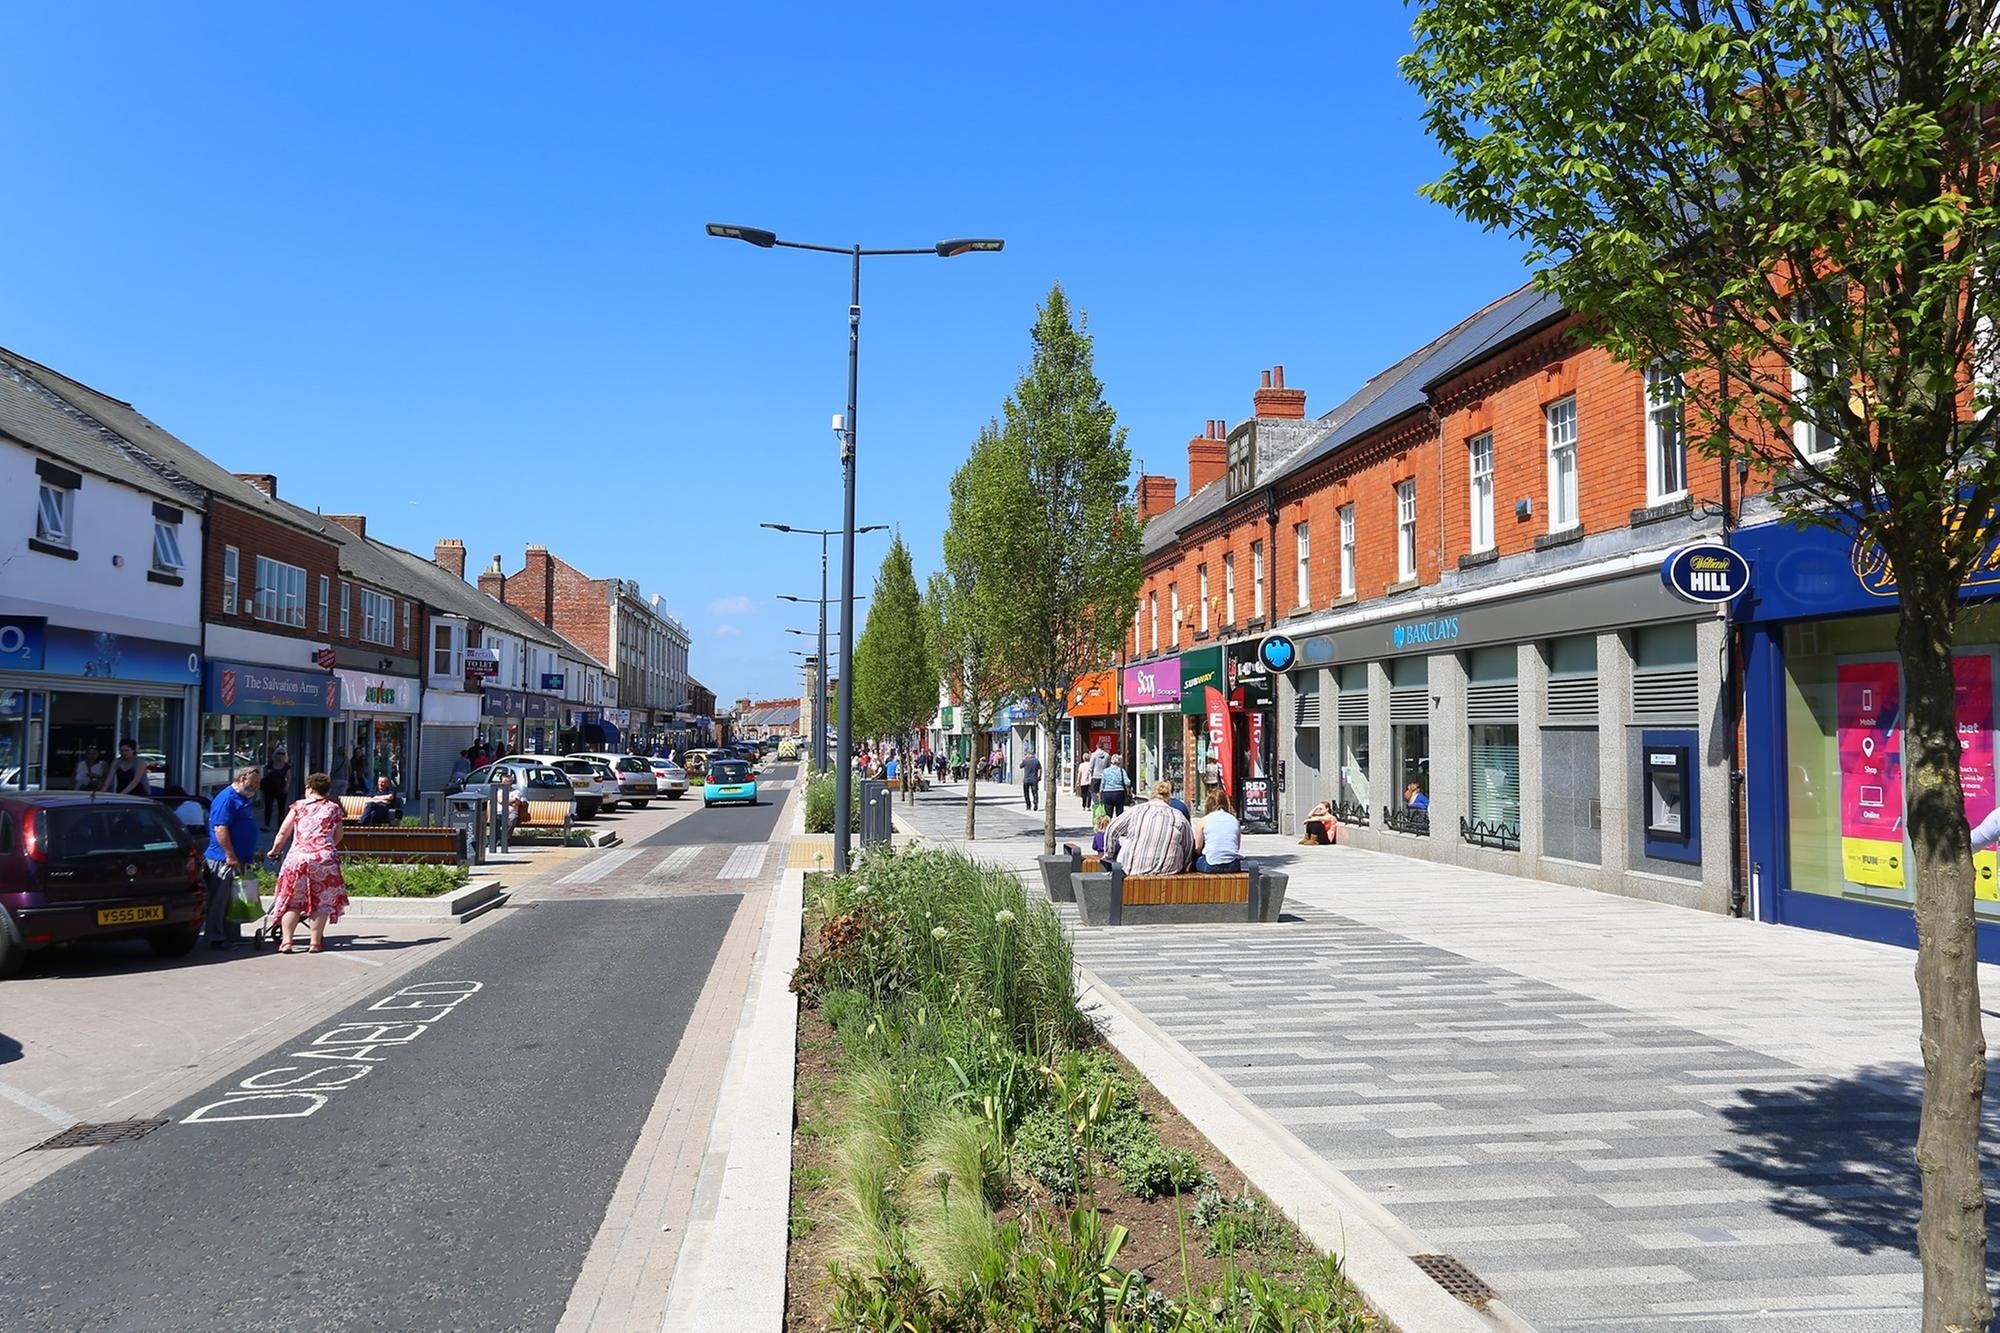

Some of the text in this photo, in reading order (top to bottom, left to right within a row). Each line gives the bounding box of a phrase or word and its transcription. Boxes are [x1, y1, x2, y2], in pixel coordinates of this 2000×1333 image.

[1690, 572, 1730, 591] HILL
[1406, 617, 1459, 645] BARCLAYS
[466, 660, 478, 668] TO
[244, 674, 261, 689] The
[262, 677, 298, 693] Salvation
[299, 681, 320, 697] Army
[1183, 671, 1215, 690] SUBWAY
[1859, 718, 1877, 726] Mobile
[1959, 722, 1980, 734] bet
[1864, 765, 1877, 775] Shop
[1245, 781, 1267, 791] RED
[1246, 798, 1268, 806] SALE
[1863, 811, 1880, 820] Online
[102, 906, 160, 922] YS55 DMX
[179, 980, 484, 1124] DISABLED
